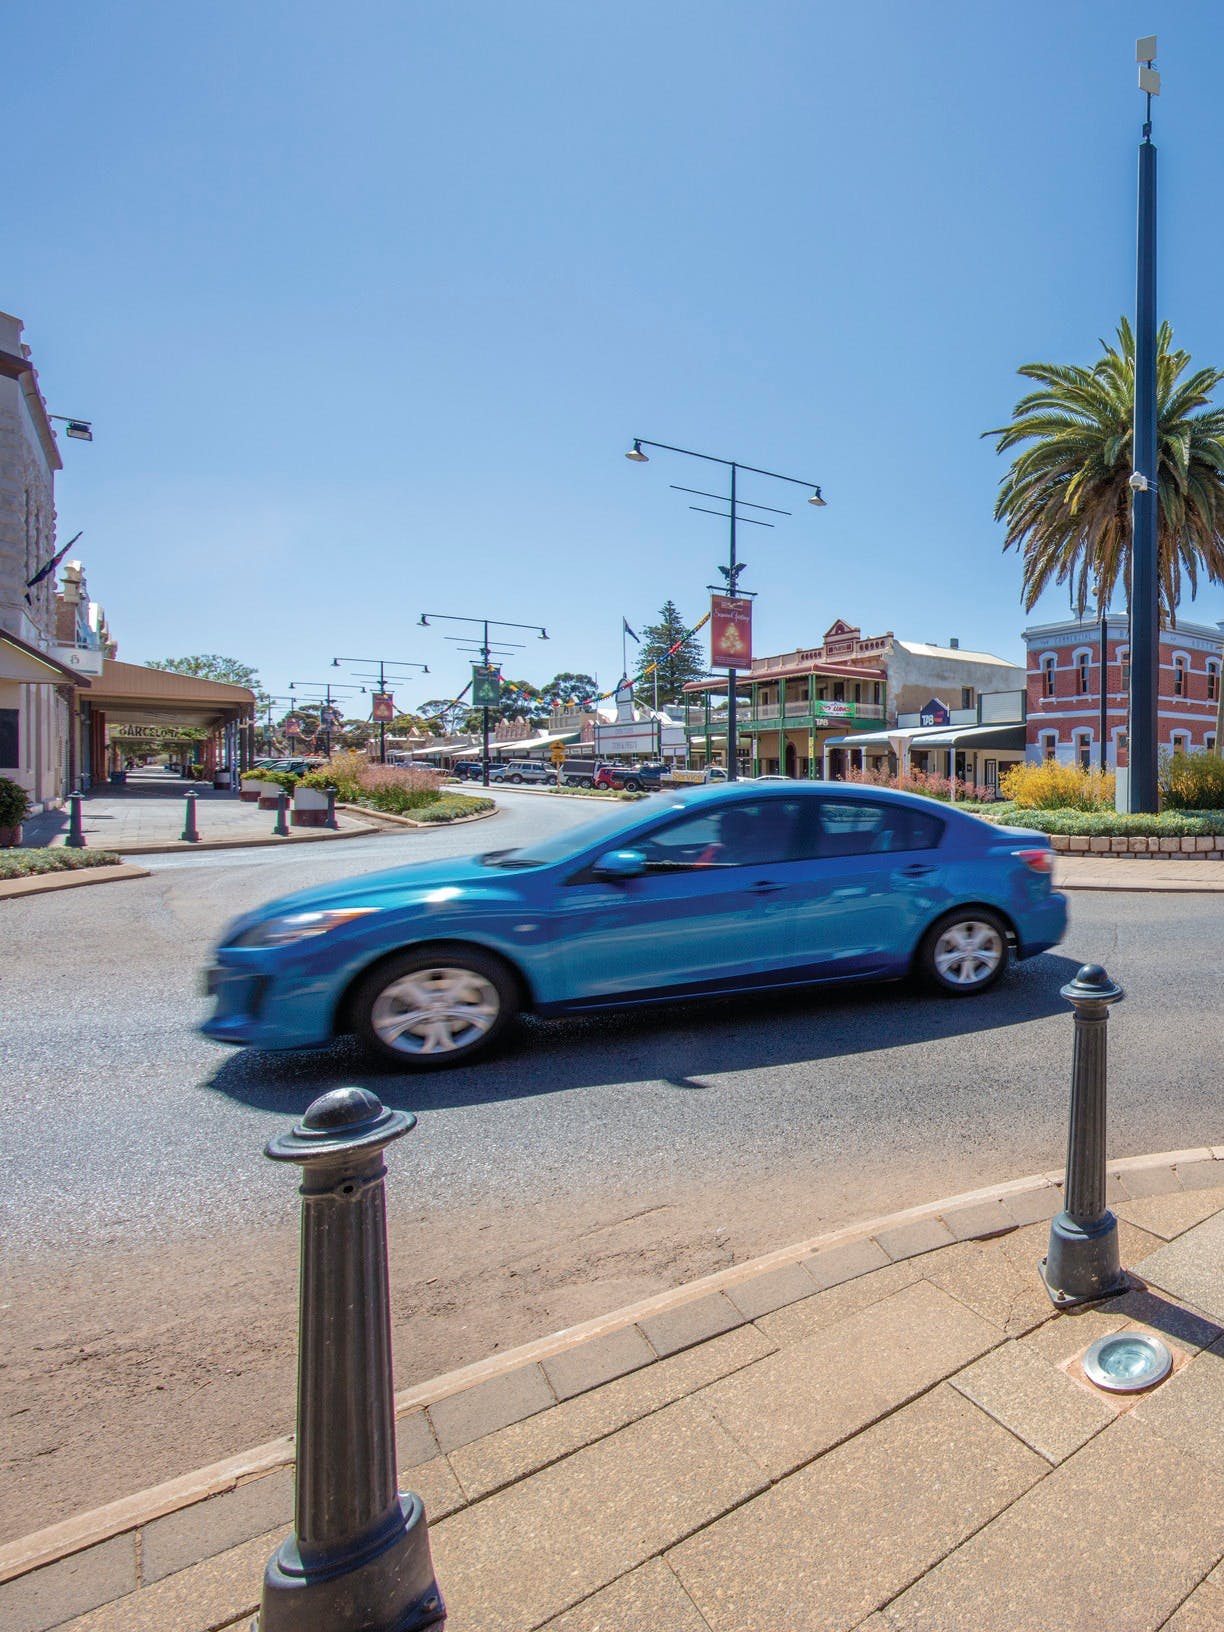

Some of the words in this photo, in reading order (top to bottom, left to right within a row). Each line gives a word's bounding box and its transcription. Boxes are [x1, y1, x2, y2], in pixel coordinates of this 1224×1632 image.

[816, 718, 829, 726] TAB
[922, 715, 934, 726] TAB
[672, 770, 703, 783] Service
